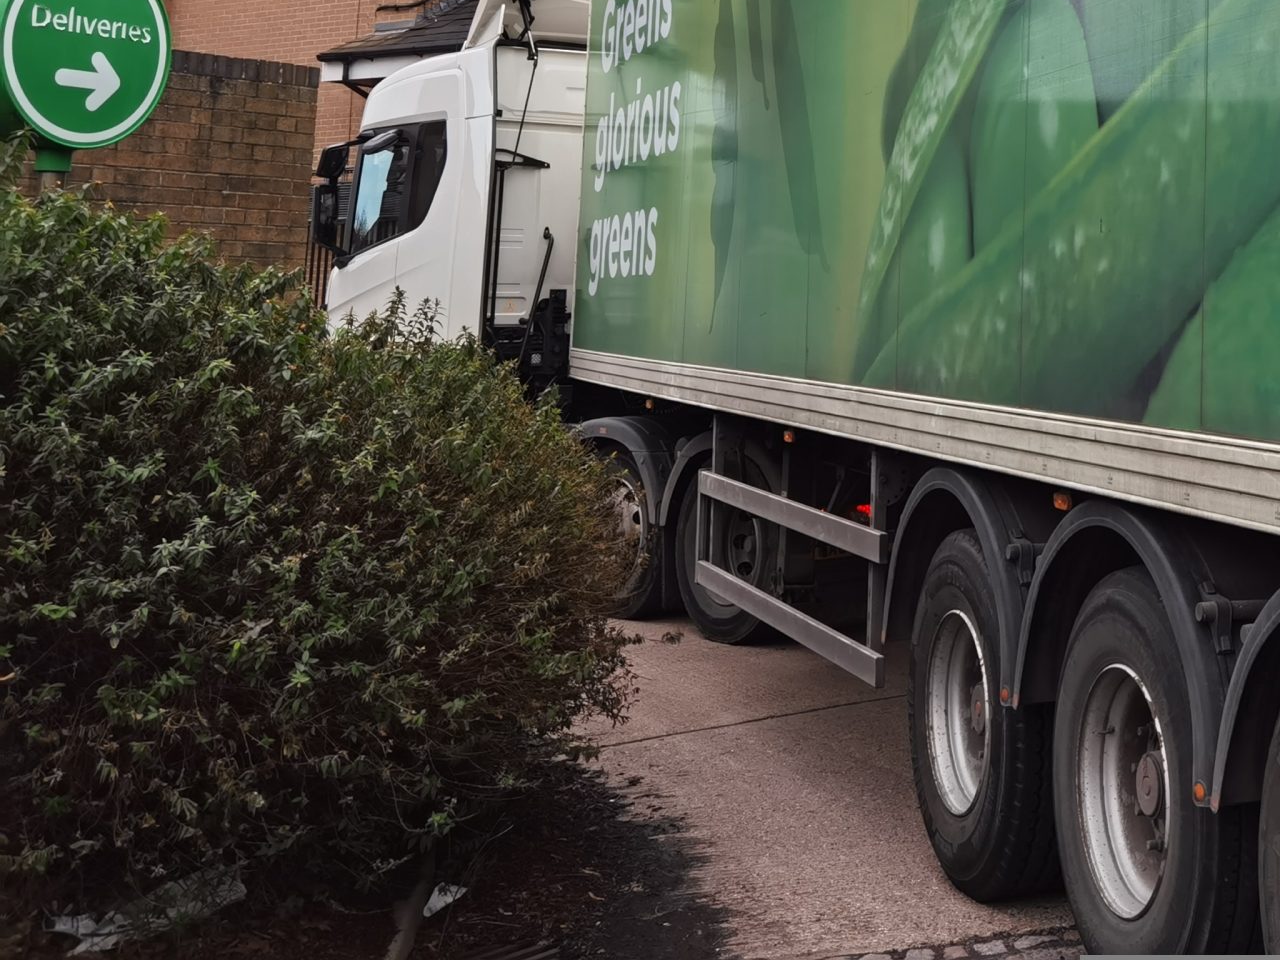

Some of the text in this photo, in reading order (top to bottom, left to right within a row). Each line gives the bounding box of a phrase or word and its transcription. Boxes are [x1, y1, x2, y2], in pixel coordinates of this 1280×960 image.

[31, 4, 151, 44] Deliveries
[594, 77, 681, 192] glorious
[588, 206, 658, 297] greens
